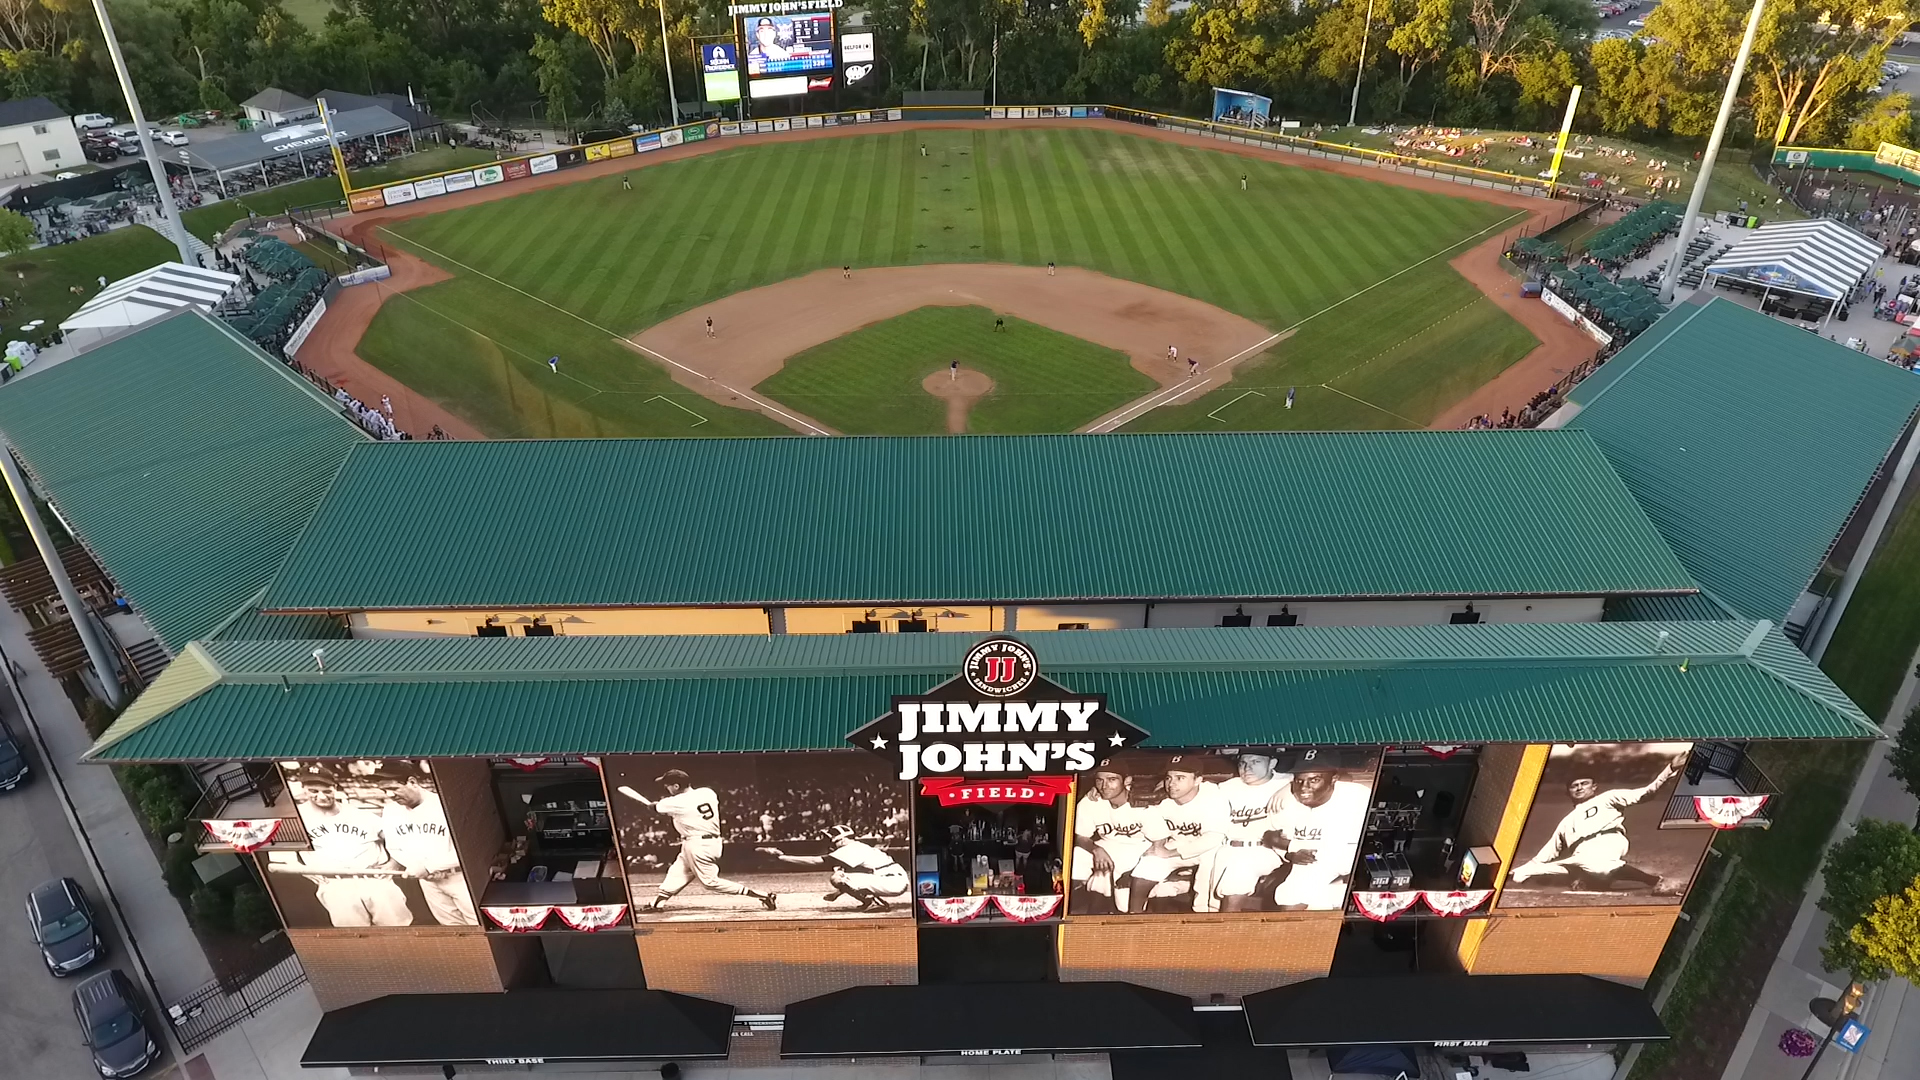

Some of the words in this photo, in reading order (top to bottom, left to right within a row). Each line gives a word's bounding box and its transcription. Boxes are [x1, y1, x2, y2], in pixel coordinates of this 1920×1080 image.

[728, 3, 767, 16] JIMMY
[768, 2, 807, 14] JOHN'S
[807, 0, 843, 10] FIELD
[273, 130, 348, 152] CHEVROET
[969, 644, 999, 669] JIMMY
[1001, 644, 1031, 670] JOHN'S
[984, 656, 1016, 683] JJ
[973, 677, 1027, 693] SANDWICHES
[898, 701, 1099, 741] JIMMY
[899, 742, 1096, 780] JOHN'S
[1304, 749, 1317, 761] B
[961, 787, 1035, 799] FIELD
[697, 802, 714, 820] 9
[1584, 805, 1598, 819] D
[334, 823, 368, 839] YORK
[485, 1057, 516, 1065] THIRD
